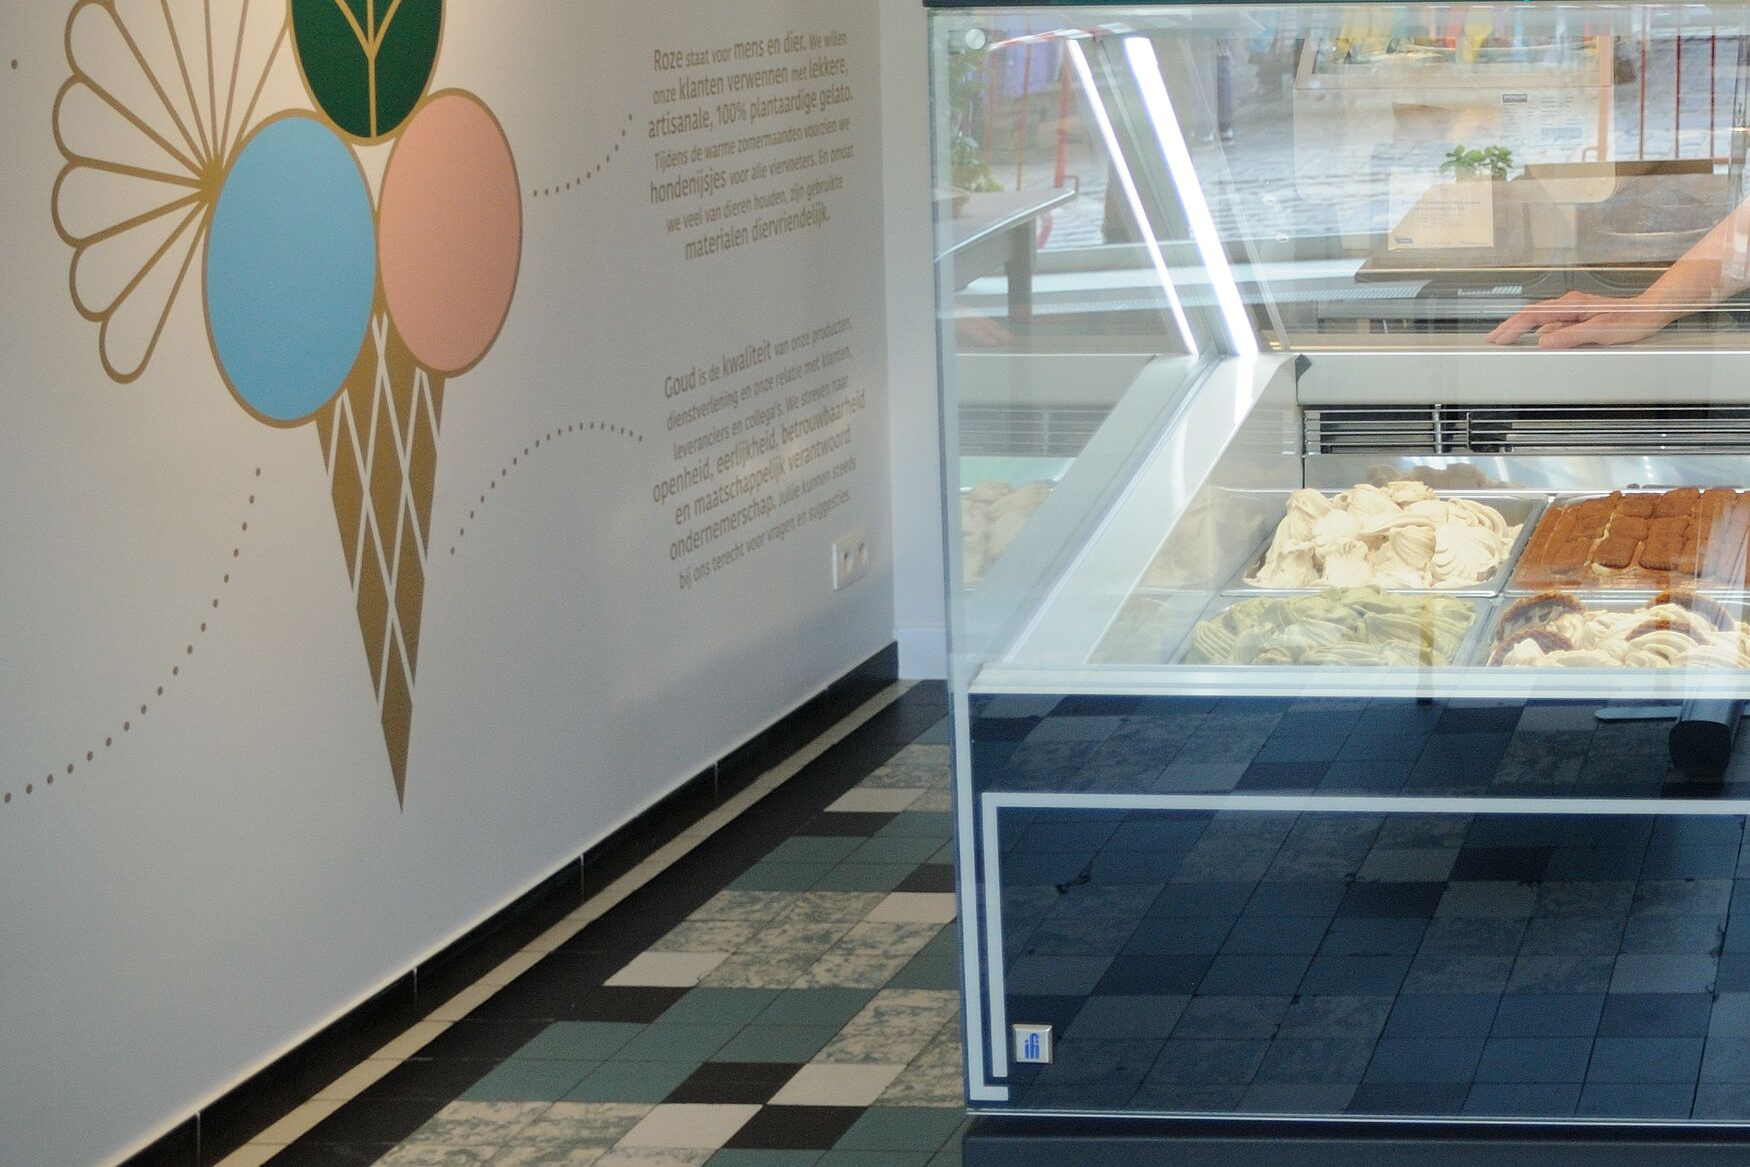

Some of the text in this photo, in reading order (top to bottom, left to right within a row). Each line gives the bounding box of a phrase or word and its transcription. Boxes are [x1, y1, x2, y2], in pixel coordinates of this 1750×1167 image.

[654, 49, 683, 72] Roze
[686, 50, 709, 67] staat
[711, 48, 731, 63] voor
[734, 39, 764, 60] mens
[767, 37, 780, 56] en
[783, 30, 806, 54] dier.
[808, 34, 822, 50] We
[653, 56, 849, 105] onze klanten verwennen met lekkere,
[648, 83, 853, 139] artisanale, 100% plantaardige gelato.
[650, 166, 726, 204] hondenijsjes
[729, 168, 750, 185] voor
[654, 150, 688, 173] Tijdens
[691, 145, 702, 163] de
[704, 141, 735, 159] warme
[666, 217, 681, 233] we
[683, 207, 703, 228] veel
[704, 206, 722, 223] van
[723, 198, 752, 219] dieren
[685, 201, 830, 261] materialen diervriendelijk.
[664, 364, 696, 399] Goud
[698, 368, 707, 386] is
[708, 363, 721, 382] de
[722, 339, 772, 377] kwaliteit
[774, 340, 789, 357] van
[791, 332, 810, 351] onze
[666, 390, 739, 432] dienstverlening
[740, 385, 753, 402] en
[753, 376, 774, 396] onze
[673, 425, 731, 462] leveranciers
[731, 421, 744, 437] en
[785, 394, 801, 413] We
[652, 455, 714, 506] openheid,
[781, 387, 865, 444] betrouwbaarheid
[675, 423, 851, 525] en maatschappelijk verantwoord
[669, 494, 776, 561] ondernemerschap.
[679, 566, 692, 590] bij
[693, 562, 710, 582] ons
[712, 543, 745, 572] terecht
